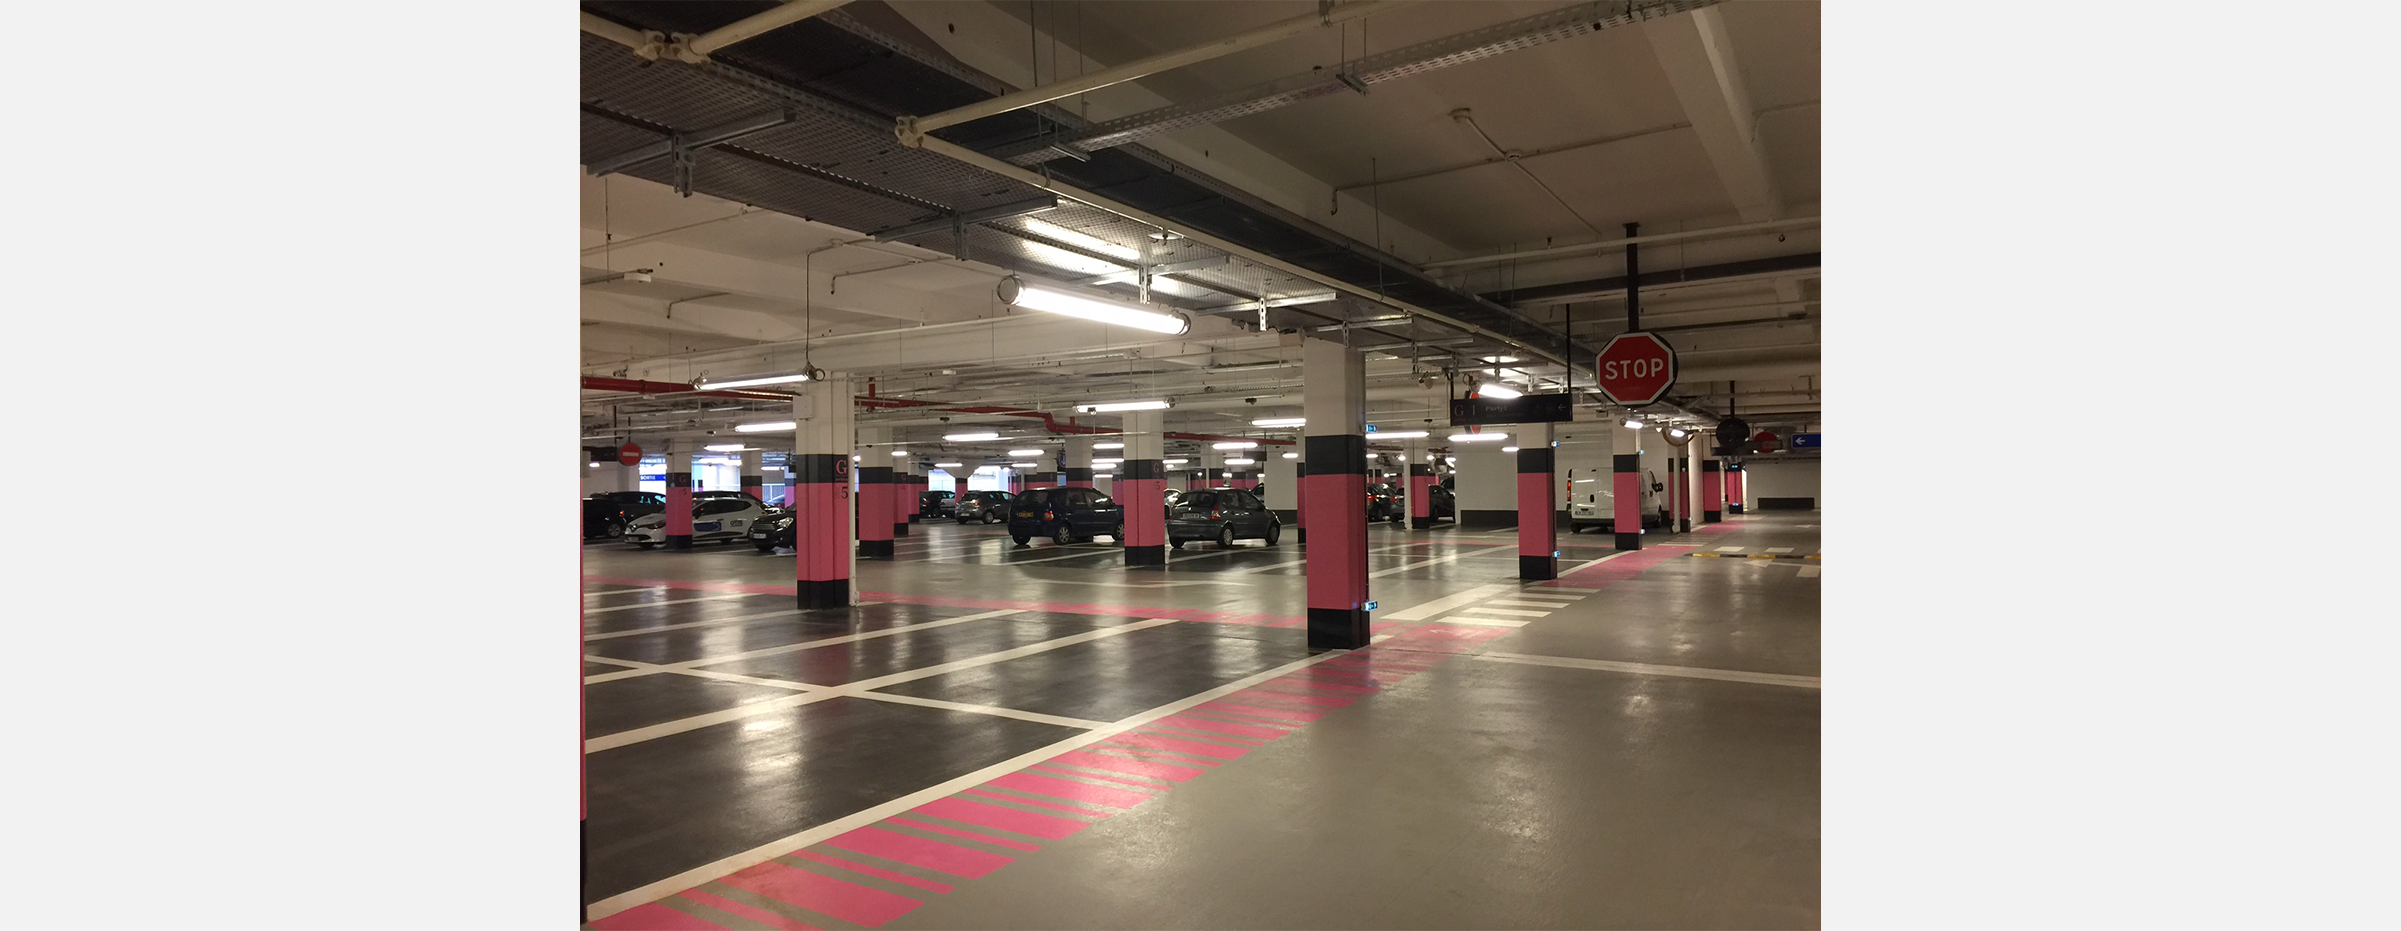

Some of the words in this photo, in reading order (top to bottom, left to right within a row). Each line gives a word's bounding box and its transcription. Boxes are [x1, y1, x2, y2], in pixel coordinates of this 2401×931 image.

[1605, 358, 1664, 380] STOP
[1453, 404, 1464, 417] G
[836, 459, 847, 475] G
[1153, 462, 1160, 474] G
[679, 474, 686, 483] G
[841, 486, 849, 499] 5
